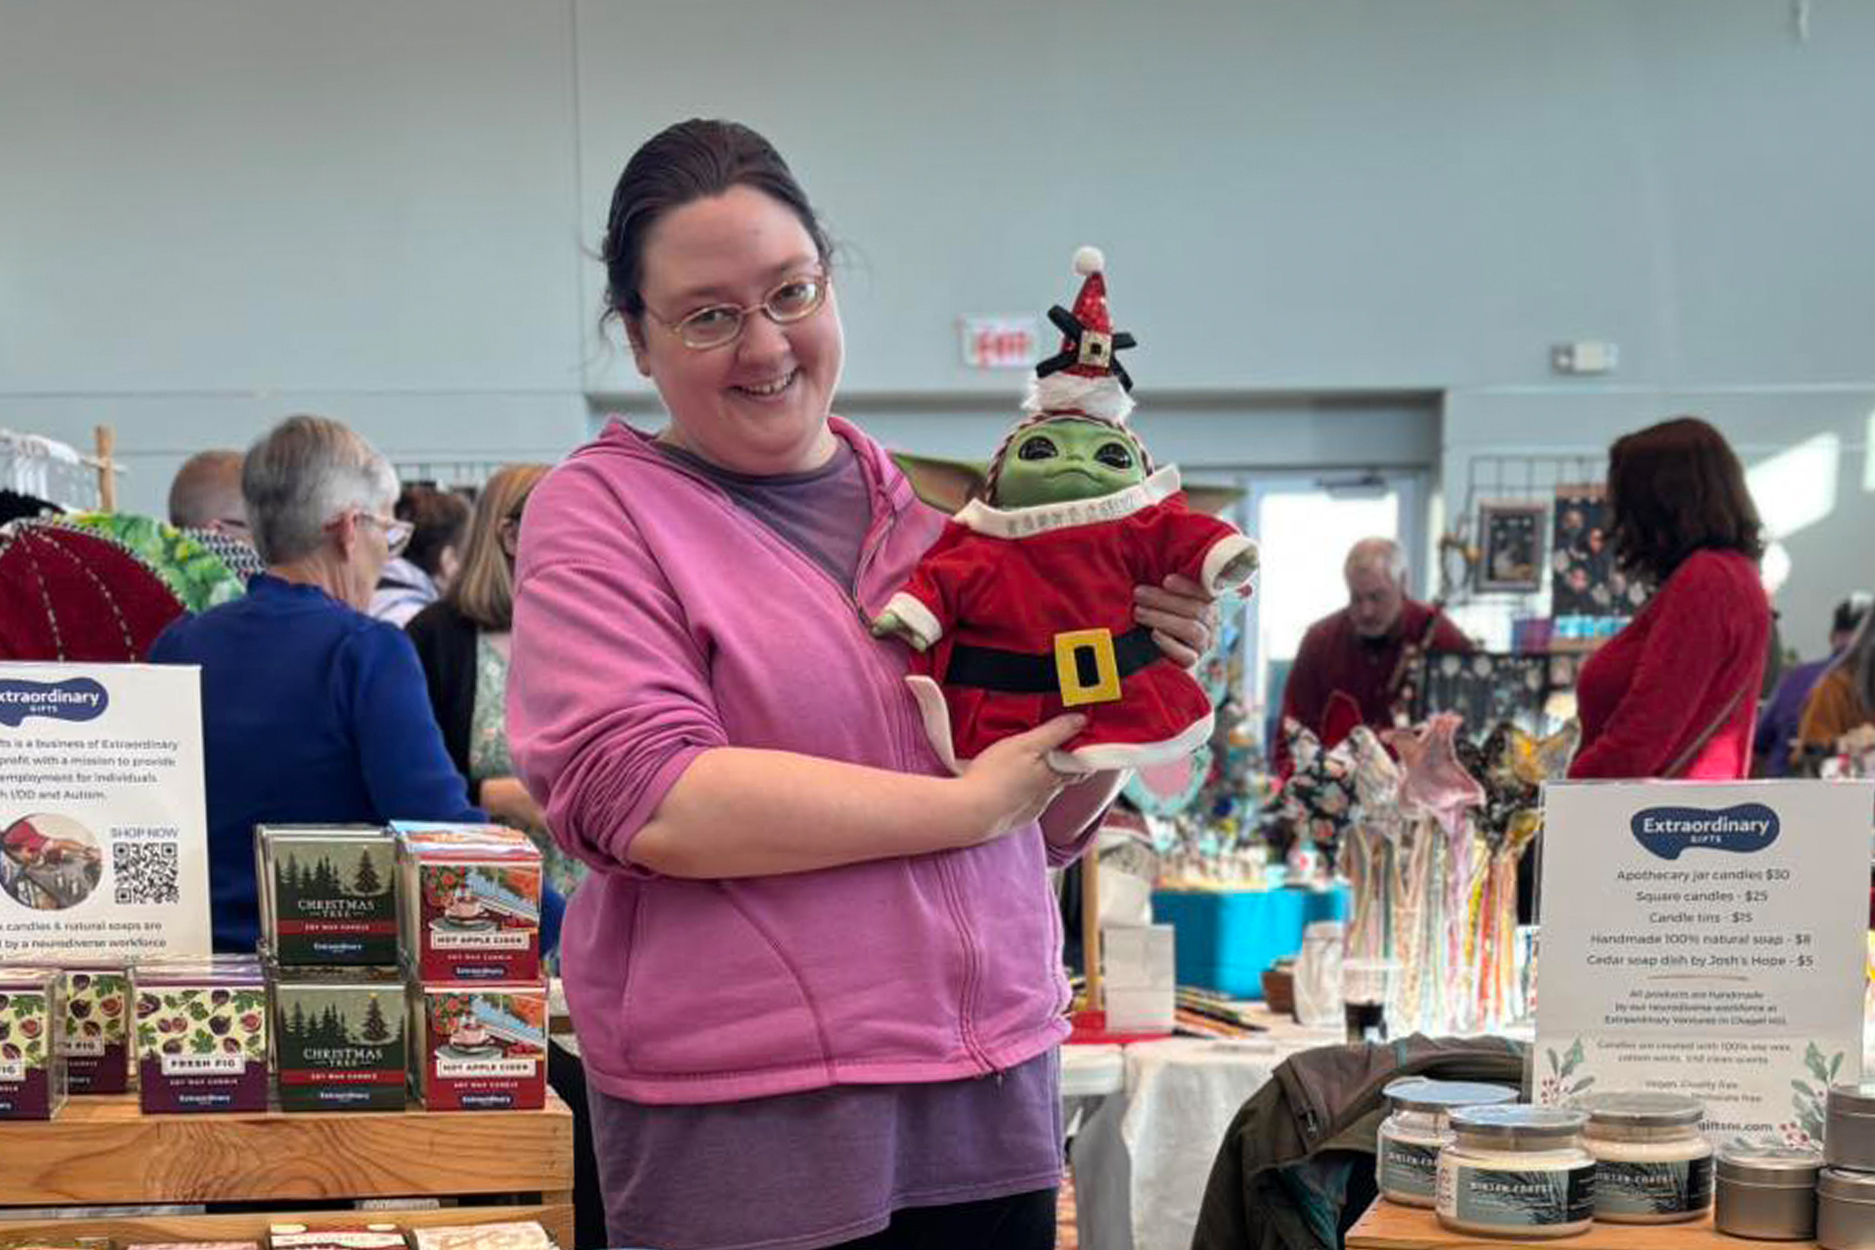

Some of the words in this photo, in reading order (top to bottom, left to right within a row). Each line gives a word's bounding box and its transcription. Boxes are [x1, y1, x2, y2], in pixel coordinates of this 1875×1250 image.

[0, 689, 99, 707] xtraordinary
[36, 739, 85, 749] business
[88, 739, 99, 749] of
[102, 739, 178, 752] Extraordinary
[33, 756, 59, 766] with
[62, 757, 69, 765] a
[71, 755, 115, 766] mission
[118, 756, 130, 766] to
[133, 756, 176, 768] provide
[77, 773, 94, 783] for
[95, 772, 156, 783] individuals
[39, 790, 60, 800] and
[1643, 816, 1770, 836] Extraordinary
[112, 828, 145, 839] SHOP
[148, 828, 179, 839] NOW
[1617, 869, 1690, 882] Apothecary
[1692, 870, 1710, 882] jar
[1711, 869, 1763, 881] candles
[1635, 891, 1682, 903] Square
[1684, 890, 1734, 902] candles
[1745, 890, 1769, 902] $25
[298, 899, 376, 911] CHRISTMAS
[321, 910, 350, 918] TREE
[1650, 911, 1695, 923] Candle
[6, 920, 50, 931] candles
[65, 921, 106, 931] natural
[108, 923, 141, 935] soaps
[144, 923, 162, 932] are
[5, 939, 18, 951] by
[31, 938, 106, 949] neurodiverse
[109, 937, 166, 949] workforce
[460, 936, 490, 944] APPLE
[493, 936, 522, 944] CIDER
[1590, 933, 1662, 945] Handmade
[1703, 933, 1750, 945] natural
[1753, 935, 1784, 948] soap
[1586, 953, 1625, 966] Cedar
[1627, 956, 1657, 969] soap
[1660, 953, 1688, 966] dish
[1690, 953, 1707, 969] by
[1752, 955, 1787, 969] Hope
[1797, 954, 1814, 968] $5
[303, 1047, 383, 1061] CHRISTMAS
[171, 1059, 210, 1068] FRESH
[215, 1059, 235, 1068] FIG
[330, 1059, 357, 1068] TREE
[466, 1062, 496, 1071] APPLE
[499, 1062, 529, 1071] CIDER
[1698, 1119, 1773, 1132] giftsnc.com
